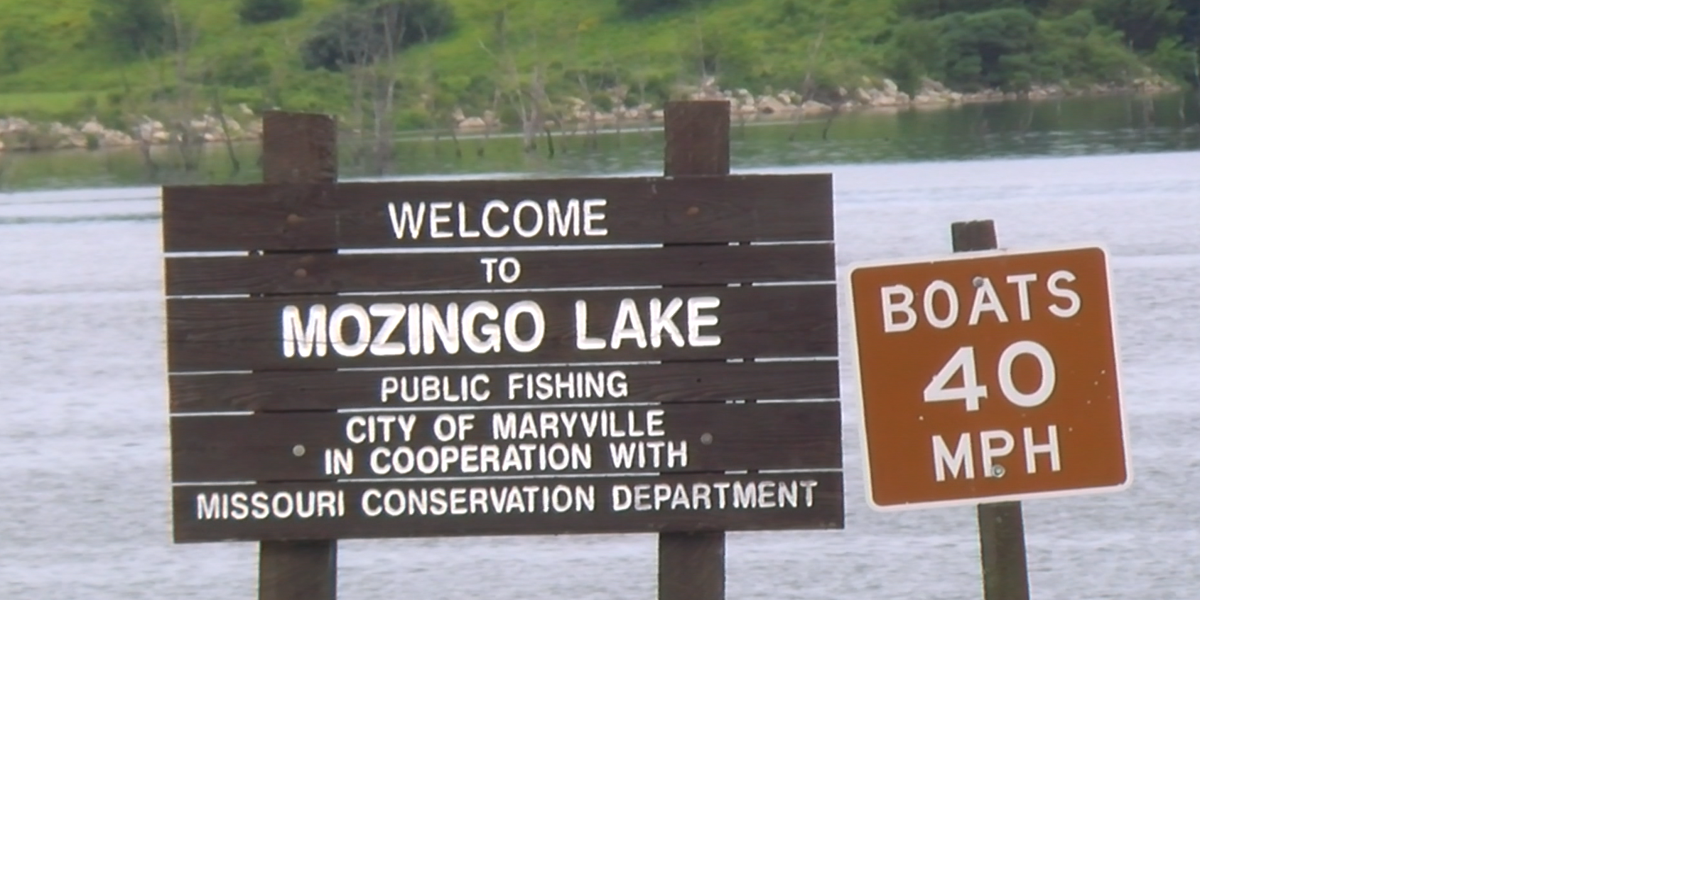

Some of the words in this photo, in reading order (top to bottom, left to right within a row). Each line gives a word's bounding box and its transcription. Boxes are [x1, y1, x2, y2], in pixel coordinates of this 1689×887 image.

[387, 199, 607, 239] WELCOME
[481, 257, 520, 283] TO
[881, 270, 1080, 332] BOATS
[282, 301, 545, 357] MOZINGO
[575, 297, 721, 350] LAKE
[381, 374, 490, 402] PUBLIC
[509, 371, 627, 400] FISHING
[924, 341, 1055, 411] 40
[345, 414, 417, 443] CITY
[434, 414, 474, 440] OF
[491, 409, 665, 440] MARYVILLE
[325, 449, 353, 475] IN
[370, 443, 591, 474] COOPERATION
[610, 441, 687, 468] WITH
[932, 425, 1060, 481] MPH
[197, 491, 344, 519] MISSOURI
[362, 485, 594, 516] CONSERVATION
[612, 481, 817, 511] DEPARTMENT
